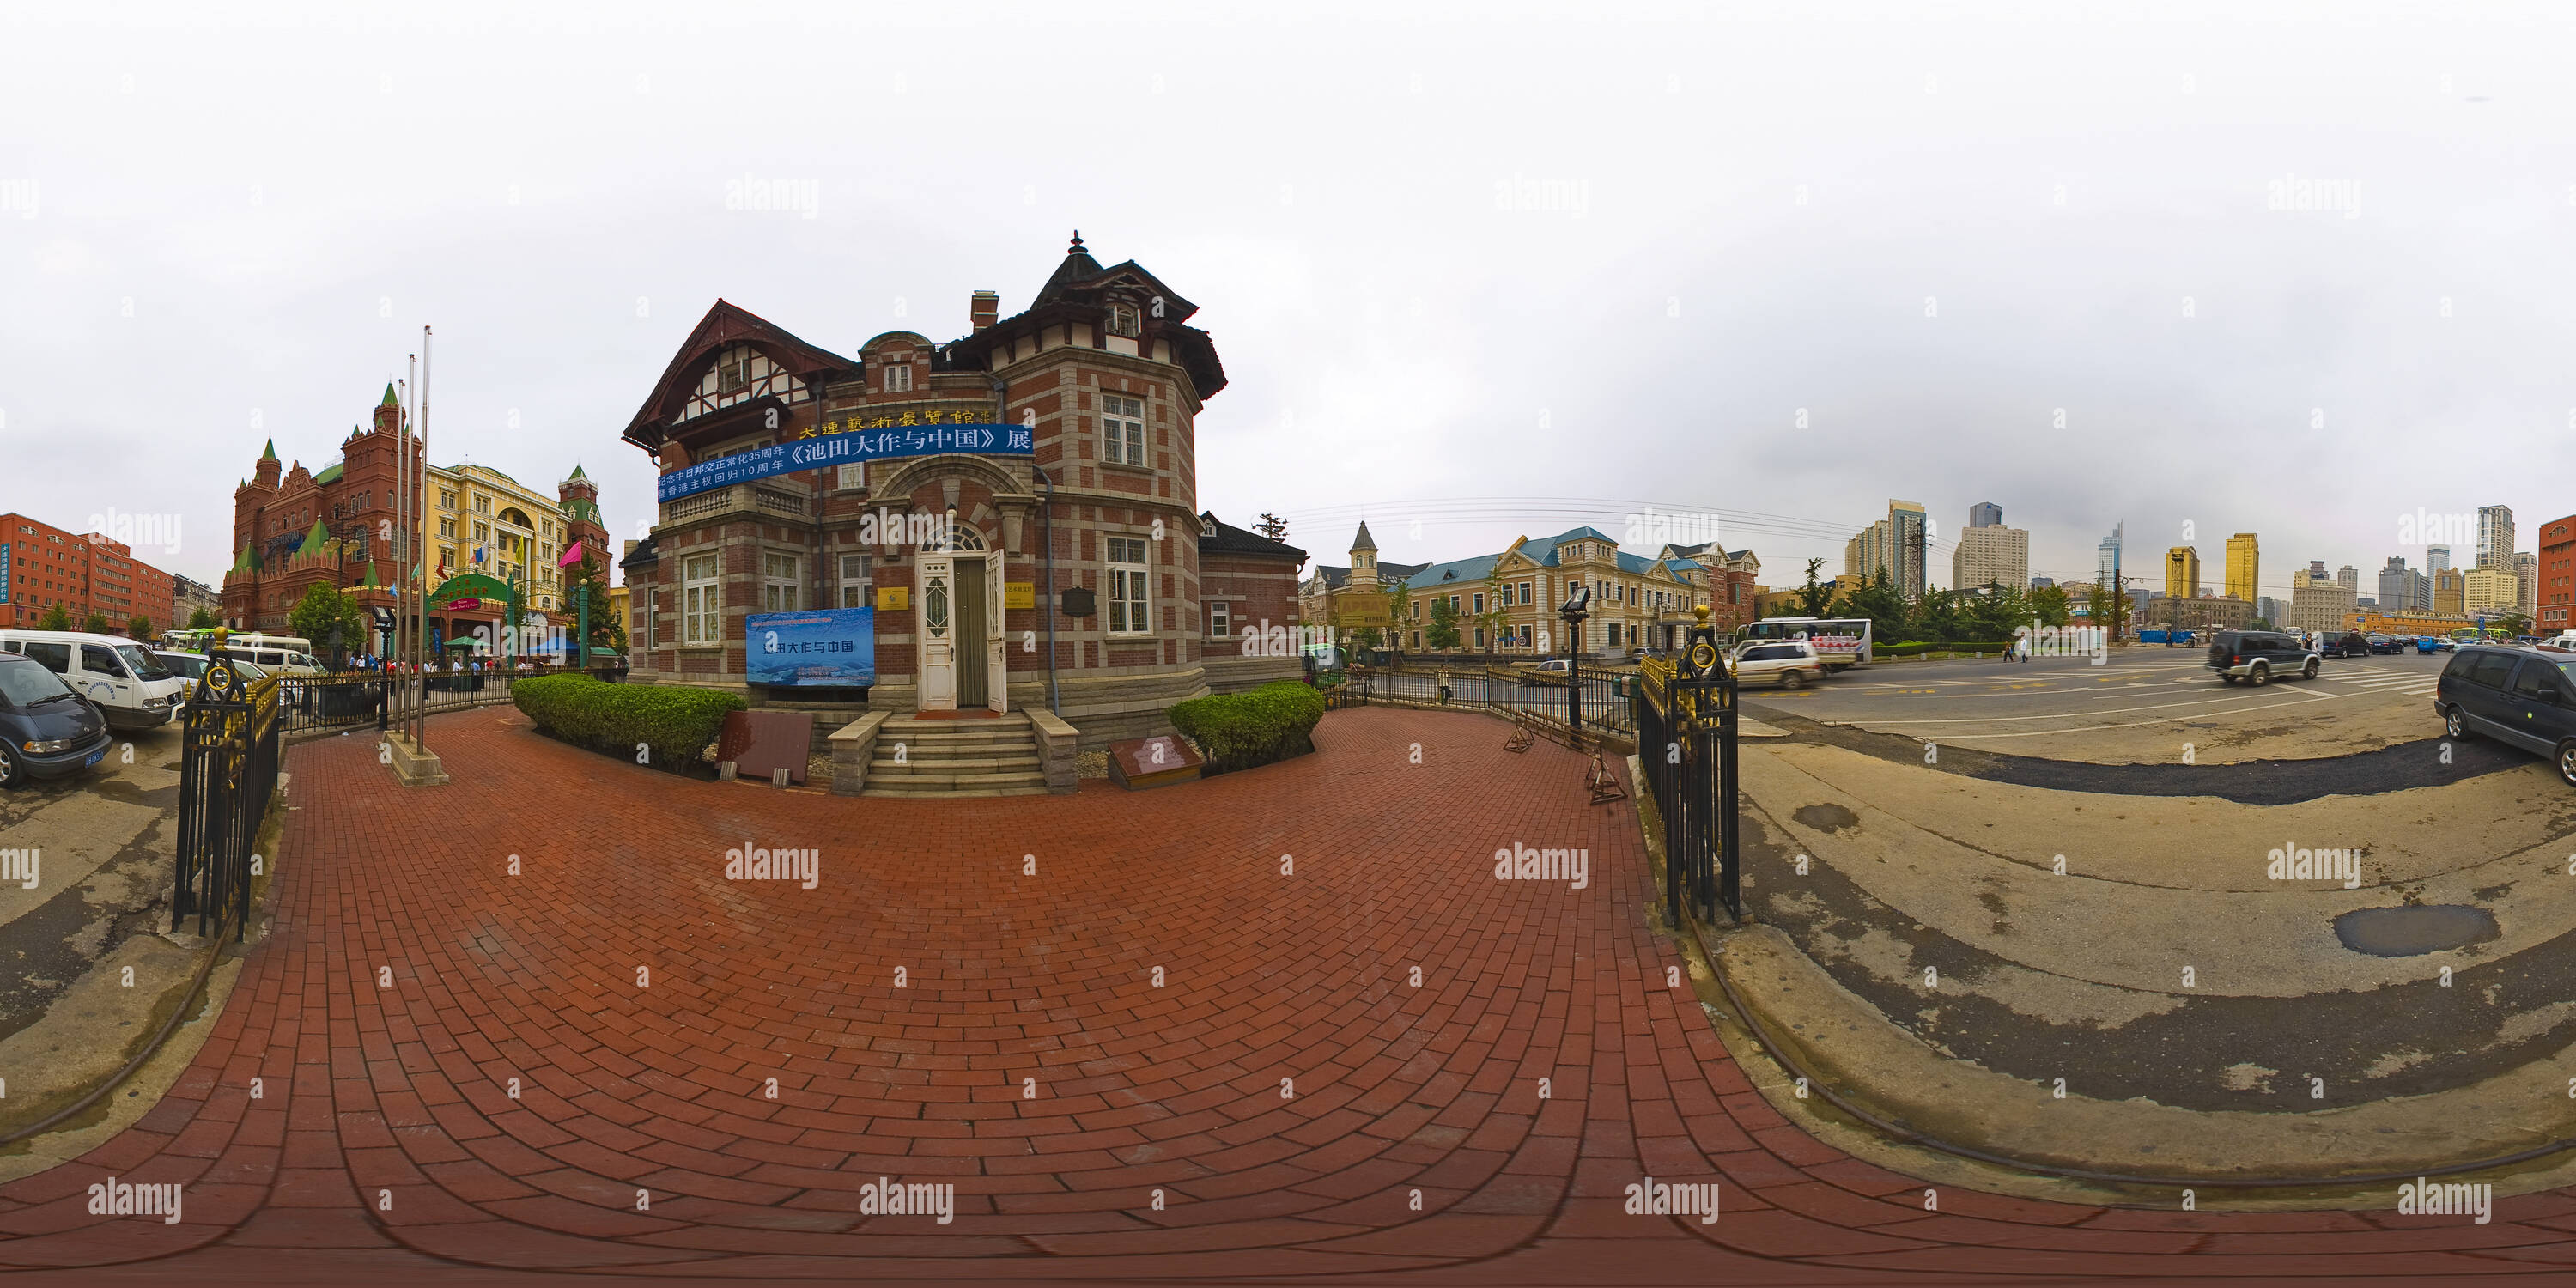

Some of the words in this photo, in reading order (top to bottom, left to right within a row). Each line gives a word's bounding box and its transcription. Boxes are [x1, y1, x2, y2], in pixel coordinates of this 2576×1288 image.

[791, 428, 995, 465] 《池田大作与中国》
[1006, 430, 1031, 449] 展
